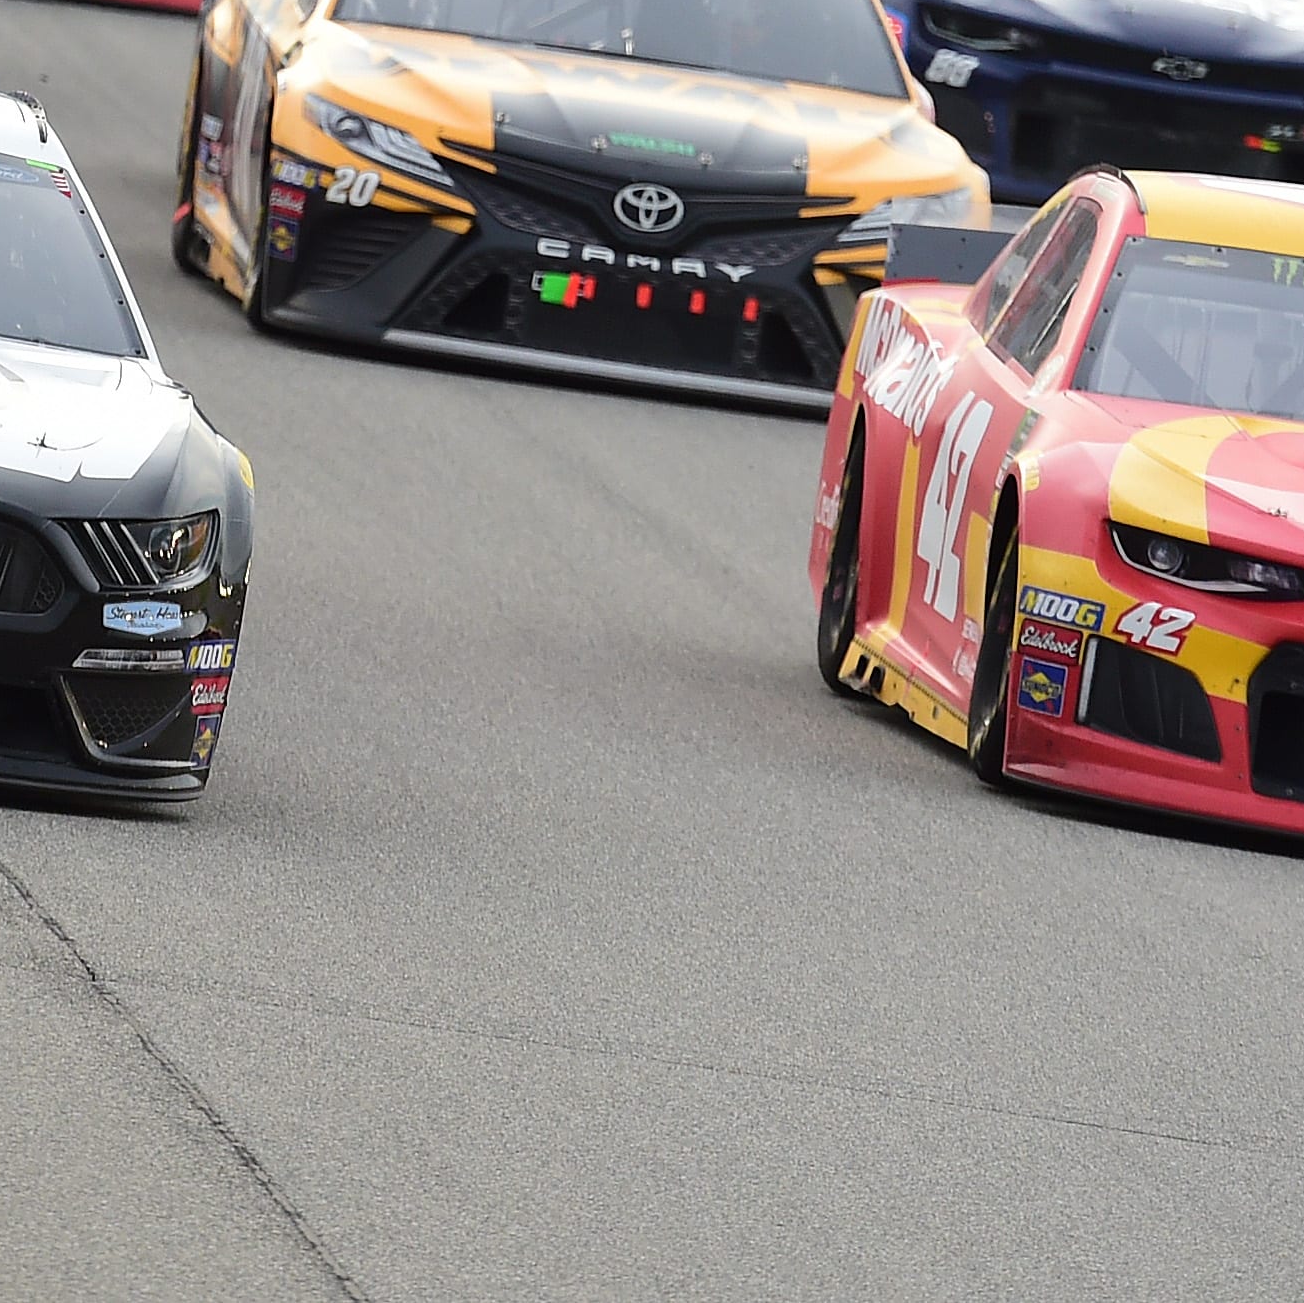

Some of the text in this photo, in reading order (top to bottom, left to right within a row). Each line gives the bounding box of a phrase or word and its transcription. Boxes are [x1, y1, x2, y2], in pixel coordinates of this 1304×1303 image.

[326, 165, 381, 207] 20
[536, 238, 756, 283] CAMRY
[917, 391, 994, 623] 42
[1019, 588, 1101, 630] MOOG
[1115, 601, 1197, 655] 42
[1020, 625, 1078, 659] Edelbrock
